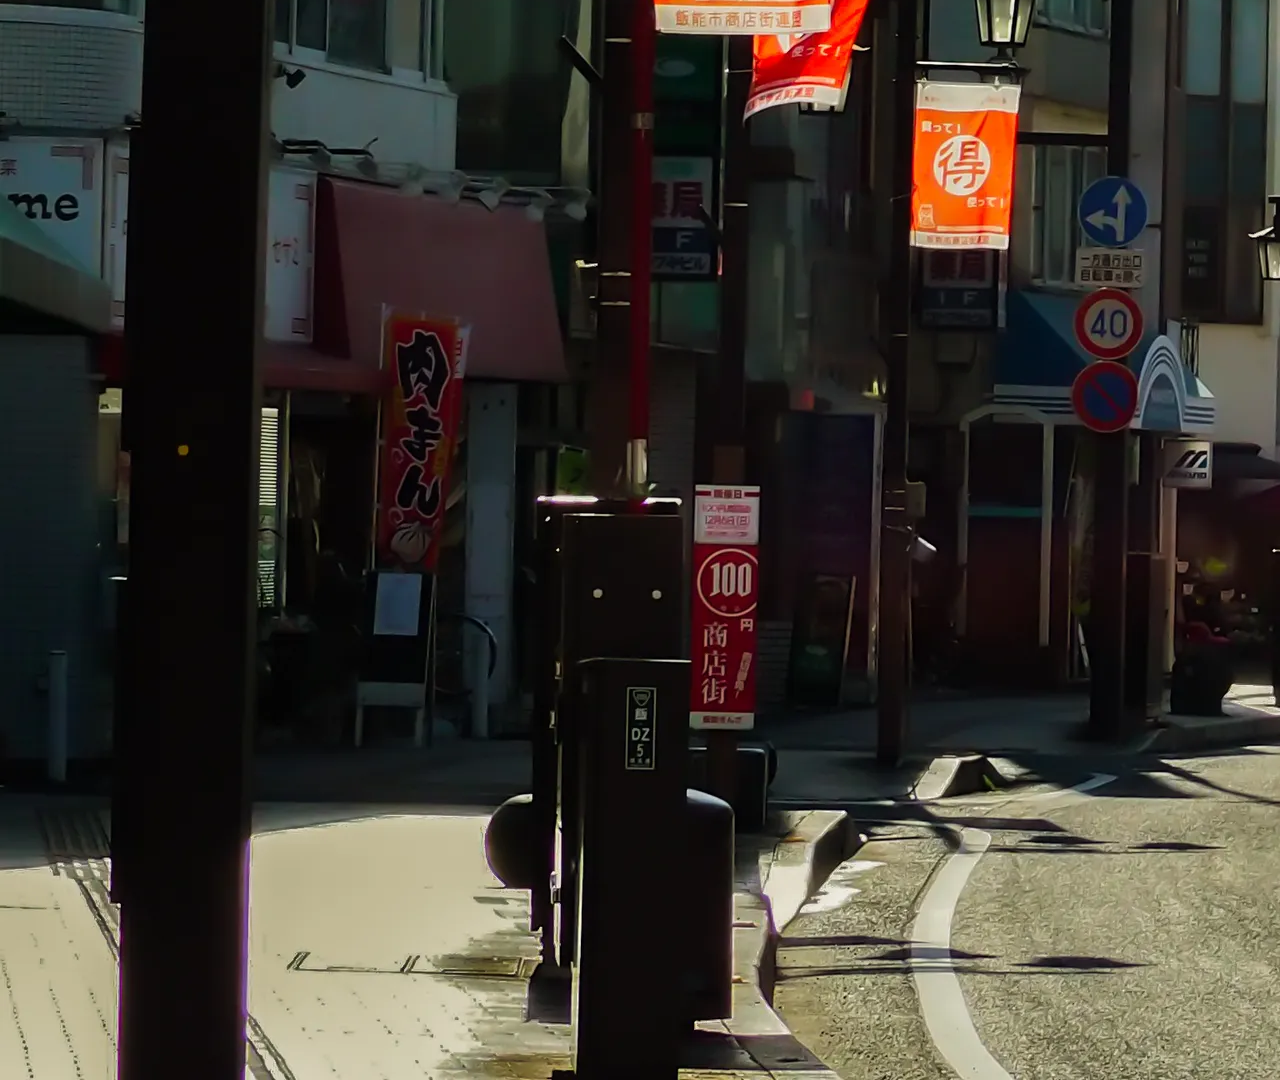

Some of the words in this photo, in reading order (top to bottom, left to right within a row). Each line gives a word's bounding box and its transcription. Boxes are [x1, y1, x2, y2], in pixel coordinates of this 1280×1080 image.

[1090, 308, 1128, 339] 40
[395, 329, 451, 519] 肉まん
[709, 561, 754, 599] 100
[740, 618, 754, 633] 円
[701, 621, 730, 706] 商店街
[631, 727, 651, 742] DZ
[636, 743, 645, 758] 5
